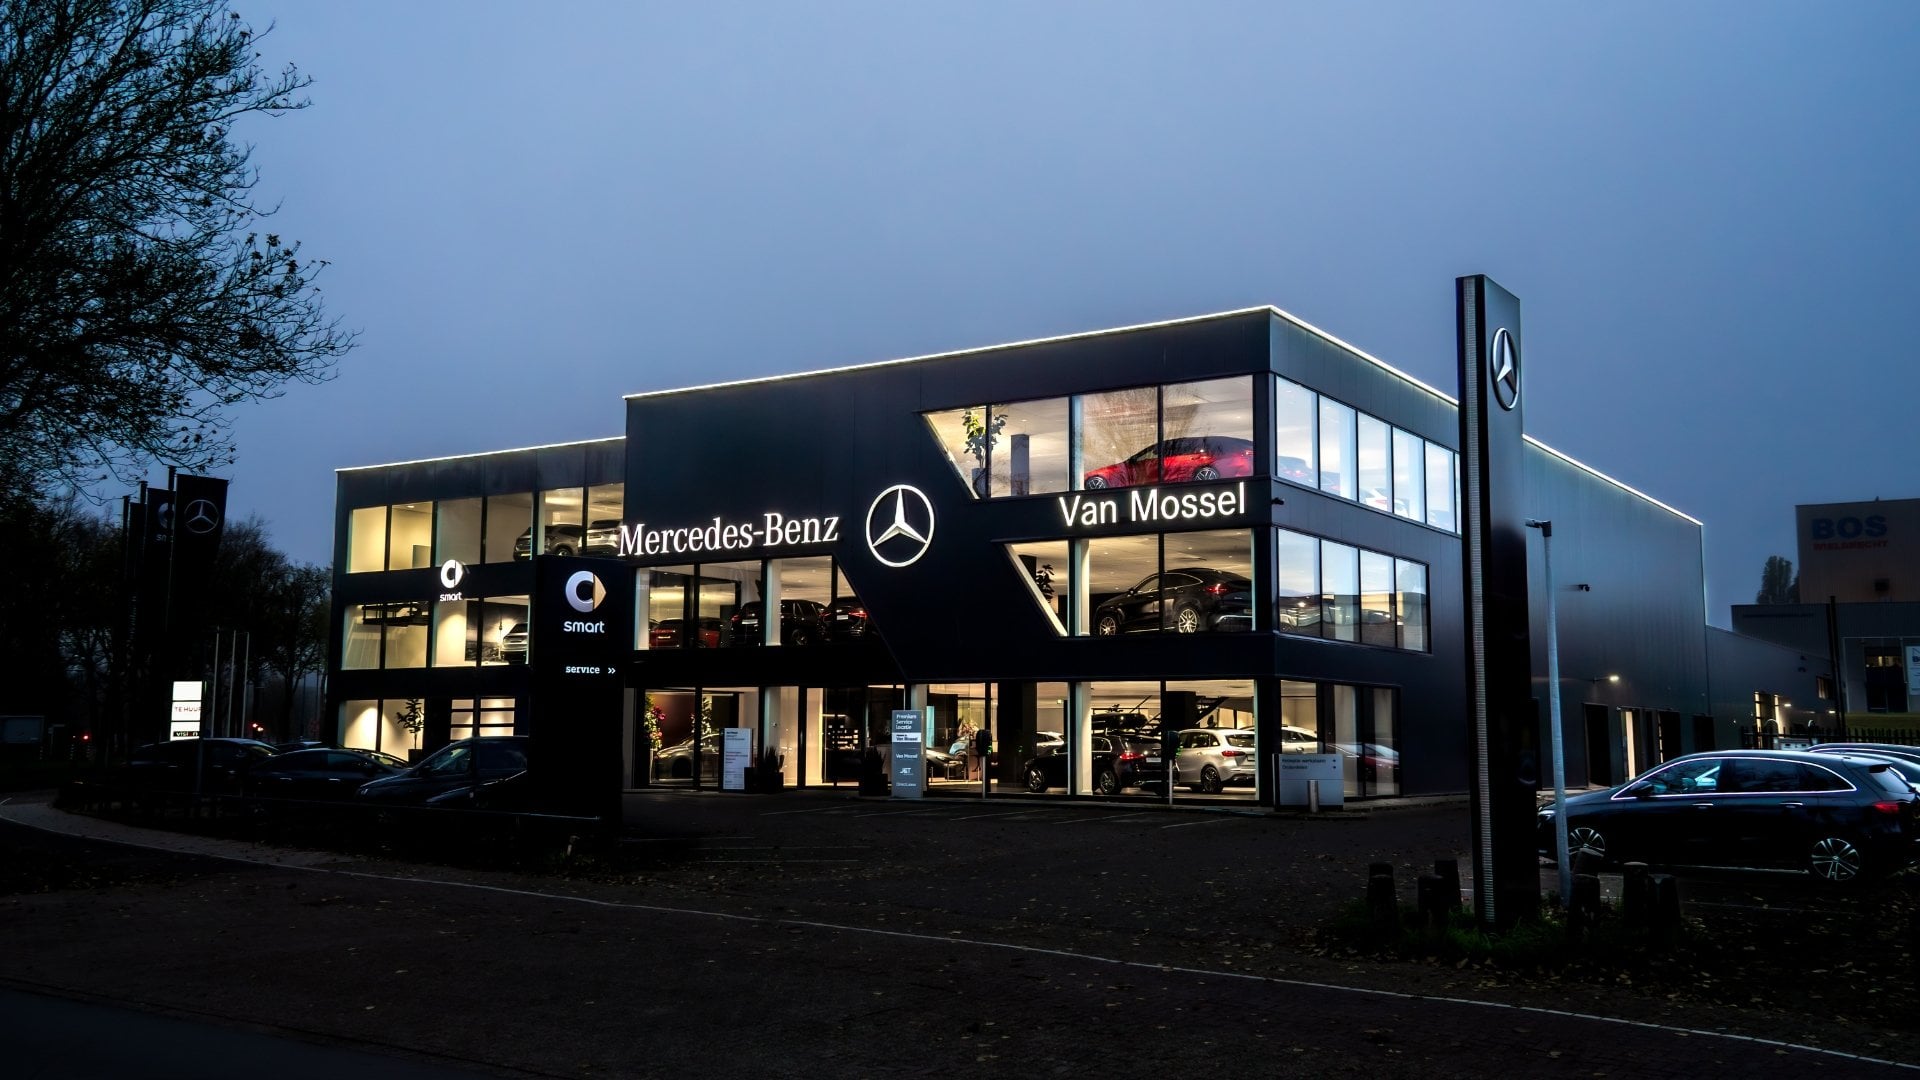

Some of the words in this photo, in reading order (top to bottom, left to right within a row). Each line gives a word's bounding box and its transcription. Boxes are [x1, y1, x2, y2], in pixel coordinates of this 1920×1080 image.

[1058, 495, 1117, 527] Van
[1131, 481, 1245, 522] Mossel
[617, 512, 840, 557] Mercedes-Benz
[1811, 515, 1888, 540] BOS
[439, 592, 463, 602] smart
[563, 620, 605, 634] smart
[565, 666, 601, 674] service
